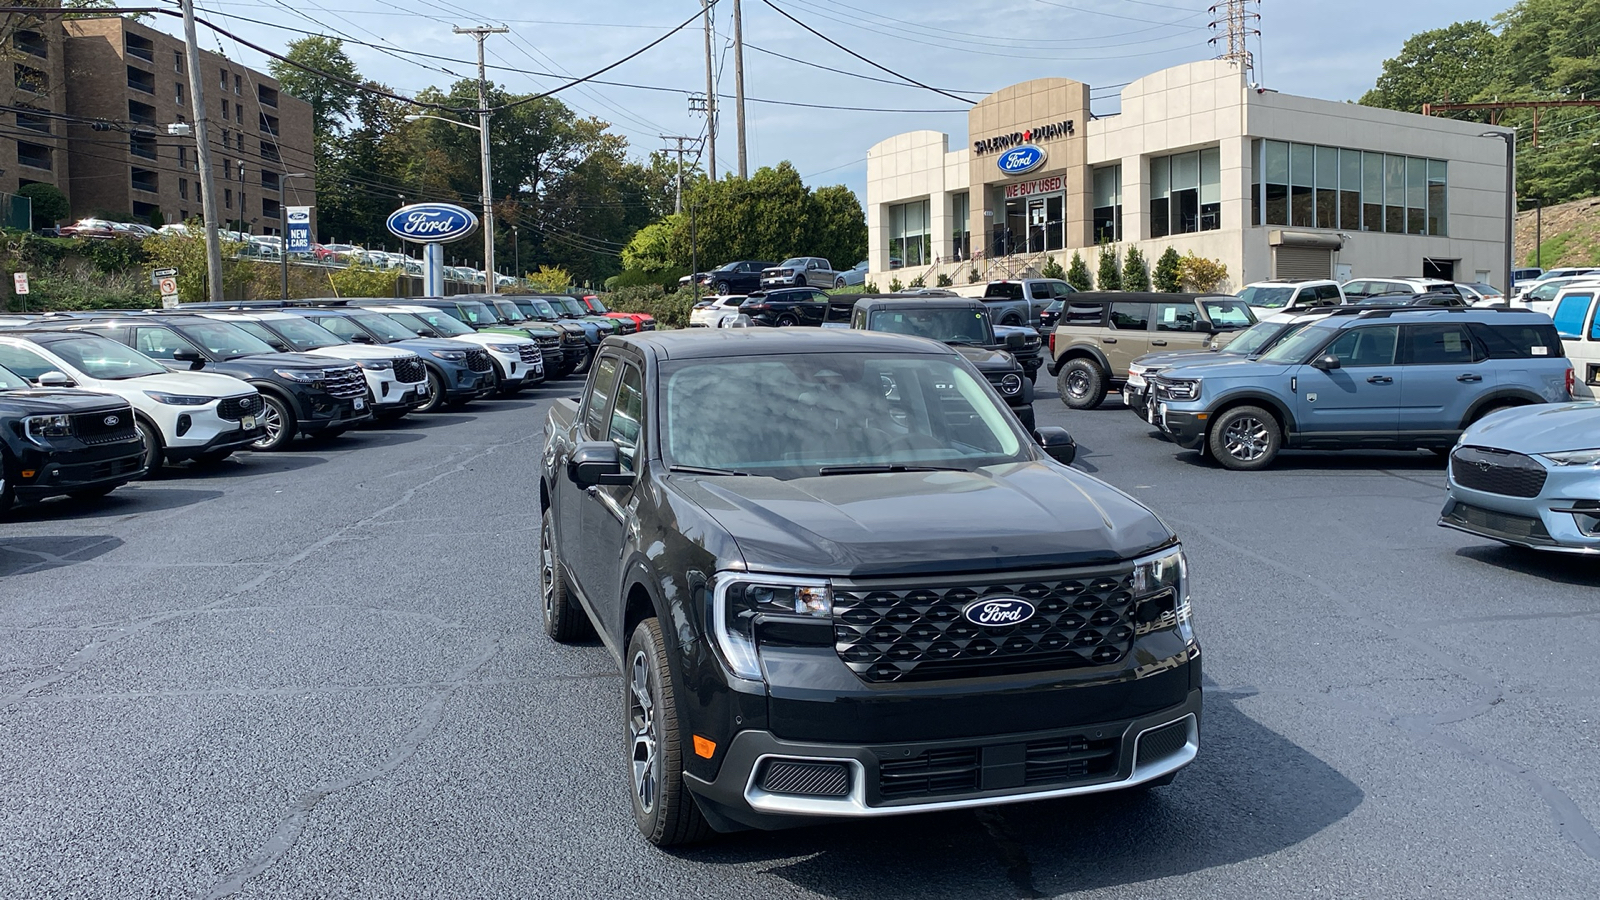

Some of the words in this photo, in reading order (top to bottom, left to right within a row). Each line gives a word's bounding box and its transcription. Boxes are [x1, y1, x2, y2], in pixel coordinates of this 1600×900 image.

[974, 132, 1023, 155] SALERNO
[1031, 120, 1075, 140] DUANE
[1006, 151, 1033, 169] Ford
[1006, 185, 1019, 198] WE
[1020, 181, 1037, 196] BUY
[1038, 177, 1062, 193] USED
[403, 211, 455, 234] Ford
[290, 229, 308, 239] NEW
[290, 239, 308, 248] CARS
[979, 602, 1023, 623] Ford
